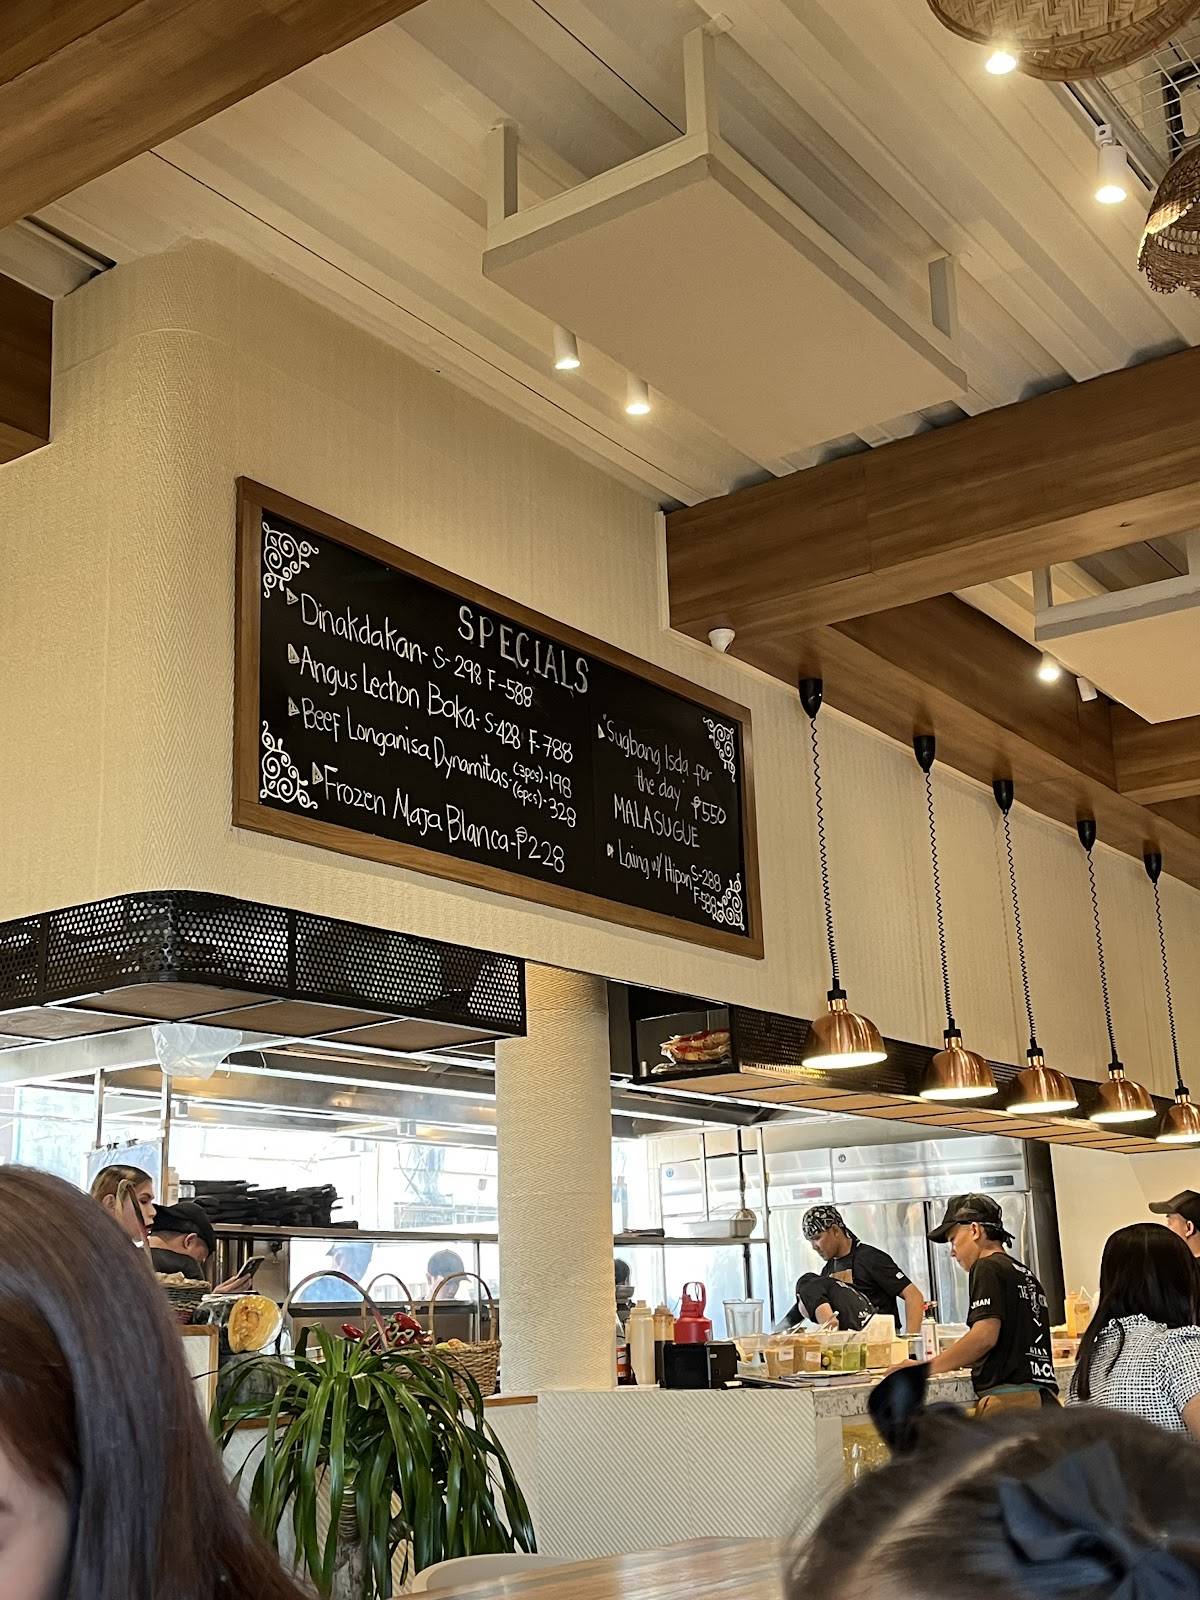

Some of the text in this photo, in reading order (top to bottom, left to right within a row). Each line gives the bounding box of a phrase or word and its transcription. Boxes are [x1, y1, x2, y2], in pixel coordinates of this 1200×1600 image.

[432, 646, 482, 685] S-298
[487, 668, 533, 707] F-588
[458, 605, 589, 693] SPECIALS
[300, 645, 358, 696] Angus
[362, 662, 420, 709] Lechon
[529, 729, 573, 763] F-788
[301, 697, 341, 742] Beef
[346, 705, 432, 760] Longanisa
[323, 765, 386, 816] Frozen
[634, 766, 655, 795] the
[658, 776, 681, 811] day
[664, 744, 689, 776] Isda
[692, 764, 713, 786] for
[614, 793, 700, 848] MALASUGUE
[618, 839, 650, 879] Laing
[664, 854, 692, 894] Hipon
